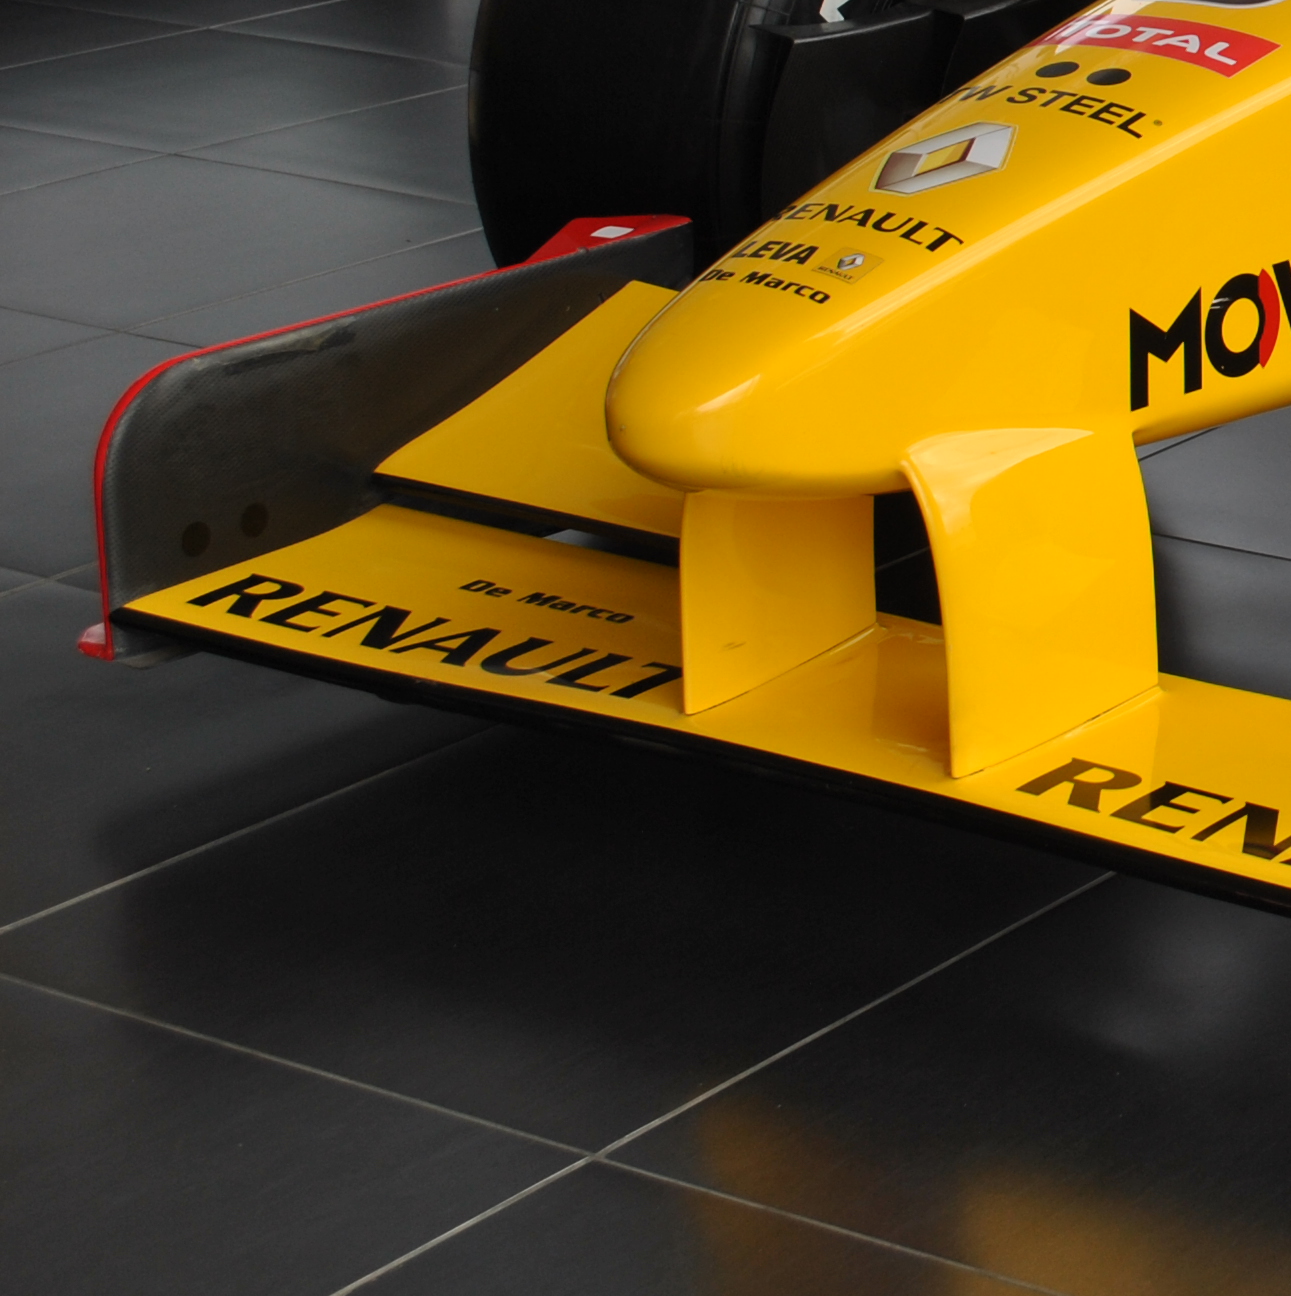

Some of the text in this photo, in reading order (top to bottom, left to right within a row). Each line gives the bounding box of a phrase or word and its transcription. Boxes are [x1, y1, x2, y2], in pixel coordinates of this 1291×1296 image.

[1058, 16, 1238, 66] TOTAL
[1007, 86, 1152, 139] STEEL
[733, 240, 819, 265] LEVA
[699, 269, 831, 304] De Marco
[459, 578, 635, 625] De Marco
[189, 572, 683, 699] RENAULT
